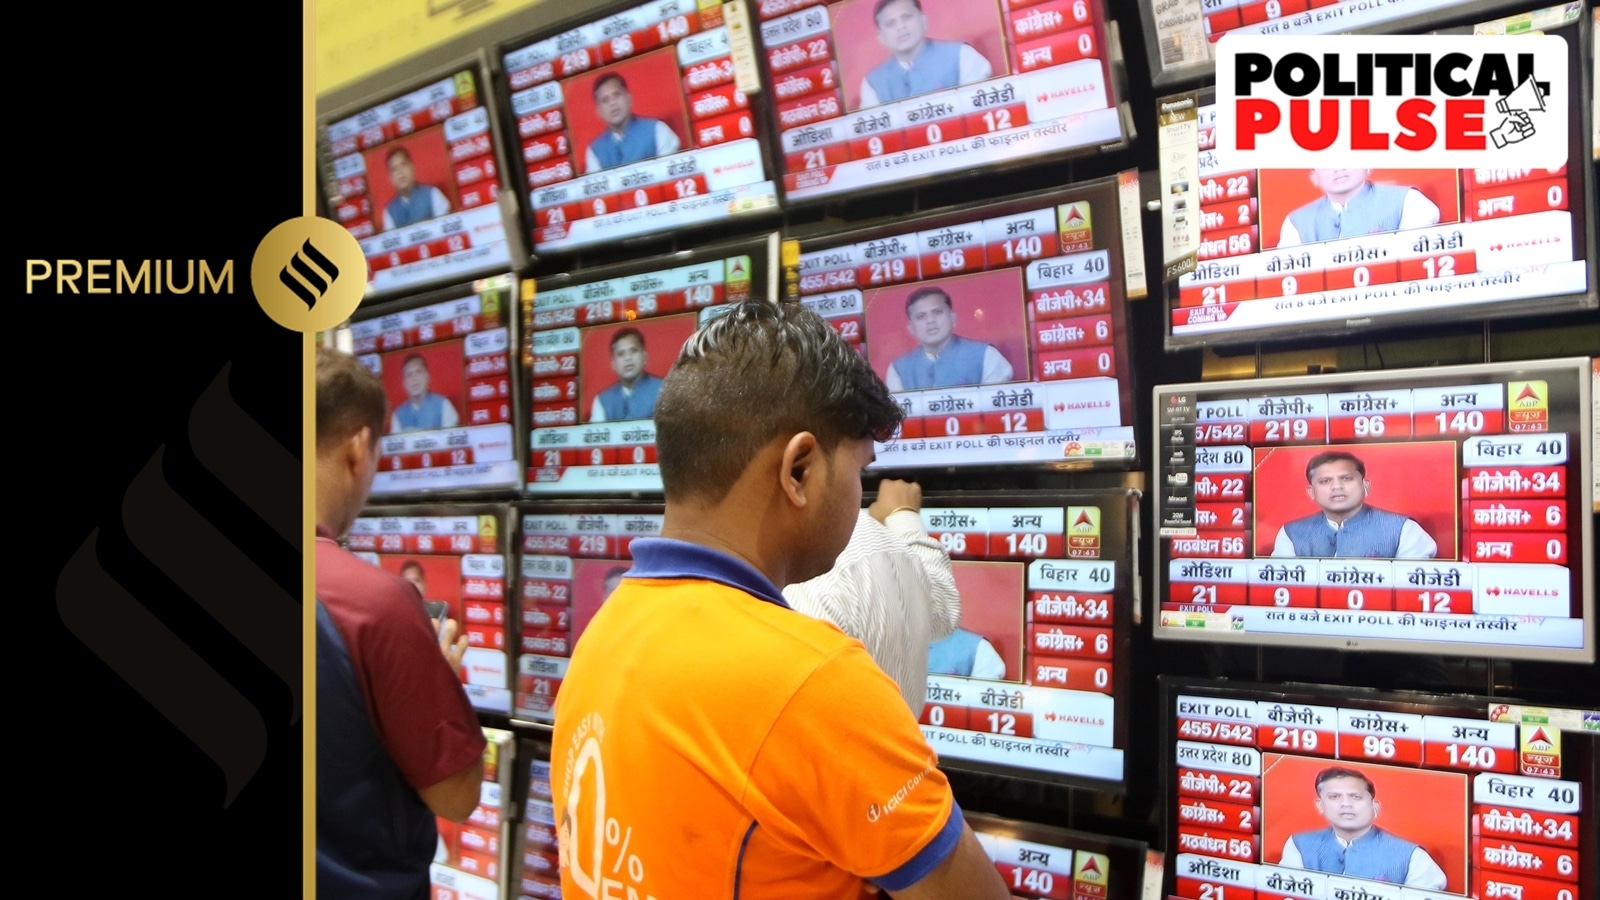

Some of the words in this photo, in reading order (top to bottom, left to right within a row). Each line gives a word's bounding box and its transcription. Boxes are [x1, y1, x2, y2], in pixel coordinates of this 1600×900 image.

[1073, 0, 1087, 22] 6
[1158, 12, 1199, 30] CASHBACK
[1317, 7, 1343, 21] EXIT
[1349, 1, 1384, 14] POLL
[657, 15, 690, 41] 140
[808, 39, 827, 58] 22
[1078, 34, 1092, 55] 0
[983, 109, 1012, 132] 12
[927, 124, 942, 144] 0
[868, 136, 883, 156] 9
[912, 151, 936, 162] EXIT
[939, 144, 968, 157] POLL
[804, 149, 827, 169] 21
[675, 178, 696, 197] 12
[1226, 176, 1248, 197] 22
[1547, 185, 1562, 207] 0
[1003, 236, 1042, 260] 140
[1229, 234, 1250, 255] 56
[824, 252, 853, 264] POLL
[939, 249, 965, 268] 96
[1084, 257, 1105, 272] 40
[1422, 255, 1456, 279] 12
[870, 259, 905, 281] 219
[1353, 266, 1369, 287] 0
[637, 295, 657, 312] 96
[684, 285, 714, 306] 140
[1202, 285, 1227, 305] 21
[1331, 293, 1360, 304] EXIT
[1364, 289, 1398, 299] POLL
[586, 302, 613, 318] 219
[1207, 305, 1223, 314] POLL
[1095, 320, 1108, 338] 6
[1043, 359, 1072, 375] अन्य
[1098, 352, 1110, 371] 0
[991, 388, 1034, 408] बीजेडी
[1067, 400, 1111, 410] HAVELLS
[1258, 397, 1314, 416] बीजेपी+
[1340, 393, 1398, 412] कांग्रेस+
[1441, 392, 1478, 407] अन्य
[1001, 412, 1028, 432] 12
[1206, 407, 1244, 419] POLL
[1435, 411, 1484, 433] 140
[945, 417, 960, 435] 0
[1265, 419, 1308, 440] 219
[1354, 416, 1385, 437] 96
[929, 441, 952, 450] EXIT
[956, 439, 984, 449] POLL
[1476, 440, 1523, 457] बिहार
[1536, 440, 1561, 456] 40
[1223, 450, 1244, 464] 80
[1221, 478, 1244, 495] 22
[1012, 514, 1042, 528] अन्य
[1473, 504, 1531, 525] कांग्रेस+
[1546, 506, 1561, 525] 6
[579, 535, 607, 553] 219
[1006, 533, 1047, 555] 140
[1222, 537, 1244, 552] 56
[1476, 541, 1513, 558] अन्य
[1546, 539, 1561, 559] 0
[1040, 563, 1079, 581] बिहार
[1089, 568, 1110, 583] 40
[1180, 561, 1233, 579] ओडिशा
[1258, 565, 1306, 583] बीजेपी
[1326, 566, 1385, 584] कांग्रेस+
[1408, 567, 1461, 587] बीजेडी
[1192, 584, 1217, 604] 21
[1274, 587, 1290, 607] 9
[1347, 589, 1364, 610] 0
[1418, 592, 1451, 612] 12
[1504, 588, 1559, 597] HAVELLS
[1179, 605, 1194, 613] EXIT
[1266, 611, 1285, 621] रात
[1289, 613, 1296, 621] 8
[1300, 610, 1320, 622] बजे
[1324, 614, 1353, 624] EXIT
[1358, 615, 1394, 625] POLL
[1398, 613, 1415, 626] की
[1420, 617, 1471, 630] फाइनल
[1476, 619, 1517, 632] तस्वीर
[1095, 634, 1108, 653] 6
[1037, 666, 1068, 683] अन्य
[1095, 668, 1108, 687] 0
[981, 687, 1024, 709] बीजेडी
[1058, 714, 1104, 726] HAVELLS
[1179, 702, 1211, 715] EXIT
[1215, 706, 1252, 719] POLL
[1267, 704, 1323, 725] बीजेपी+
[572, 713, 593, 750] EASY
[988, 713, 1015, 734] 12
[1180, 720, 1253, 741] 455/542
[1350, 714, 1408, 734] कांग्रेस+
[1452, 725, 1490, 741] अन्य
[939, 731, 967, 744] POLL
[1274, 727, 1318, 749] 219
[1362, 735, 1395, 758] 96
[1530, 743, 1551, 751] ABP
[1232, 752, 1252, 767] 80
[1446, 743, 1495, 769] 140
[1526, 766, 1555, 776] 07:43
[1229, 780, 1251, 798] 22
[1488, 777, 1534, 799] बिहार
[1548, 787, 1574, 804] 40
[882, 785, 908, 815] ICICI
[1018, 848, 1050, 866] अन्य
[1484, 845, 1542, 870] कांग्रेस+
[1557, 855, 1573, 875] 6
[1011, 867, 1053, 893] 140
[1188, 859, 1241, 881] ओडिशा
[1267, 873, 1314, 895] बीजेपी
